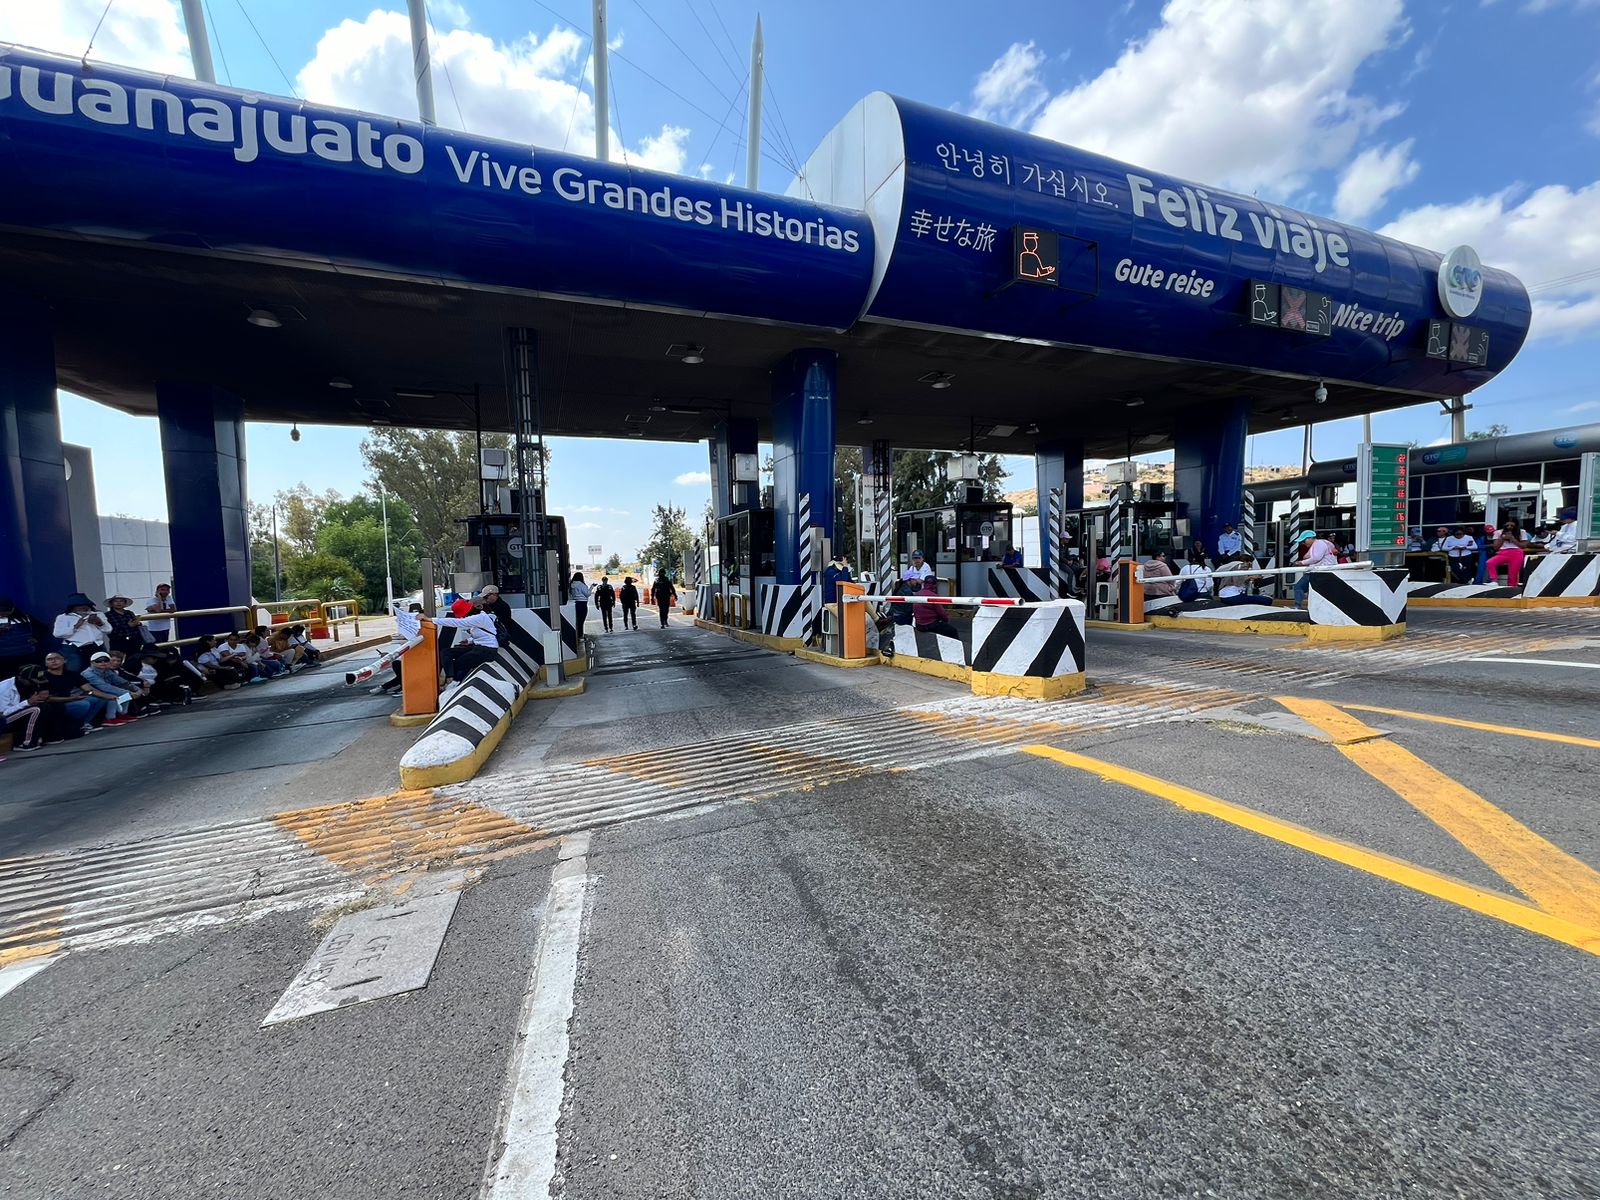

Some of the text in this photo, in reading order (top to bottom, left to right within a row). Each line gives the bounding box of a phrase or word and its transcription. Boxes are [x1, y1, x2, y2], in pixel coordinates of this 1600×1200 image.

[0, 48, 860, 254] uanajuato Vive Grandes Historias
[936, 142, 1119, 209] 안녕히 가십시오.
[910, 208, 997, 253] 幸せな旅
[1126, 173, 1350, 273] Feliz viaje
[1114, 258, 1215, 298] Gute reise
[1332, 303, 1405, 342] Nice trip
